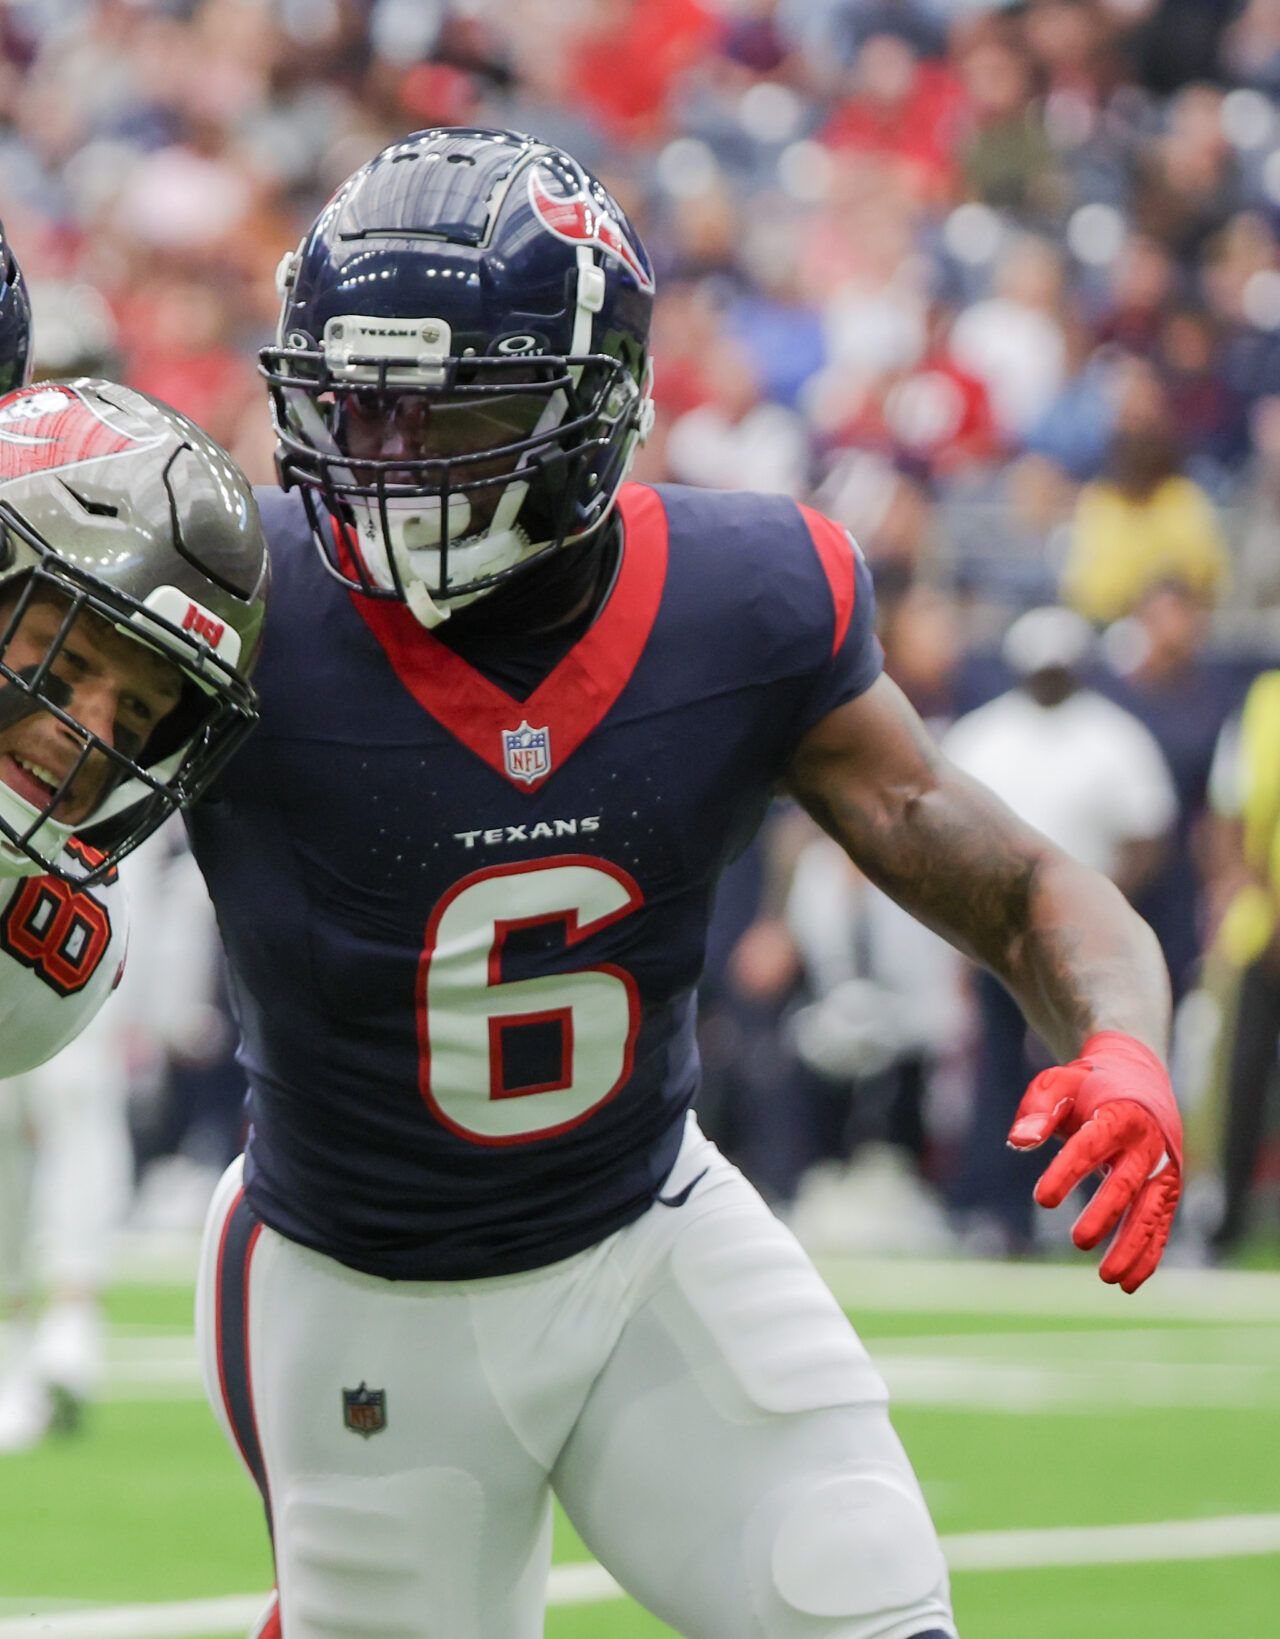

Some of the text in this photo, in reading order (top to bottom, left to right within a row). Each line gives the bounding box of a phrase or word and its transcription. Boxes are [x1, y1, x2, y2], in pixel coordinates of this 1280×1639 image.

[512, 749, 544, 772] NFL
[453, 815, 601, 849] TEXANS
[415, 853, 645, 1147] 6
